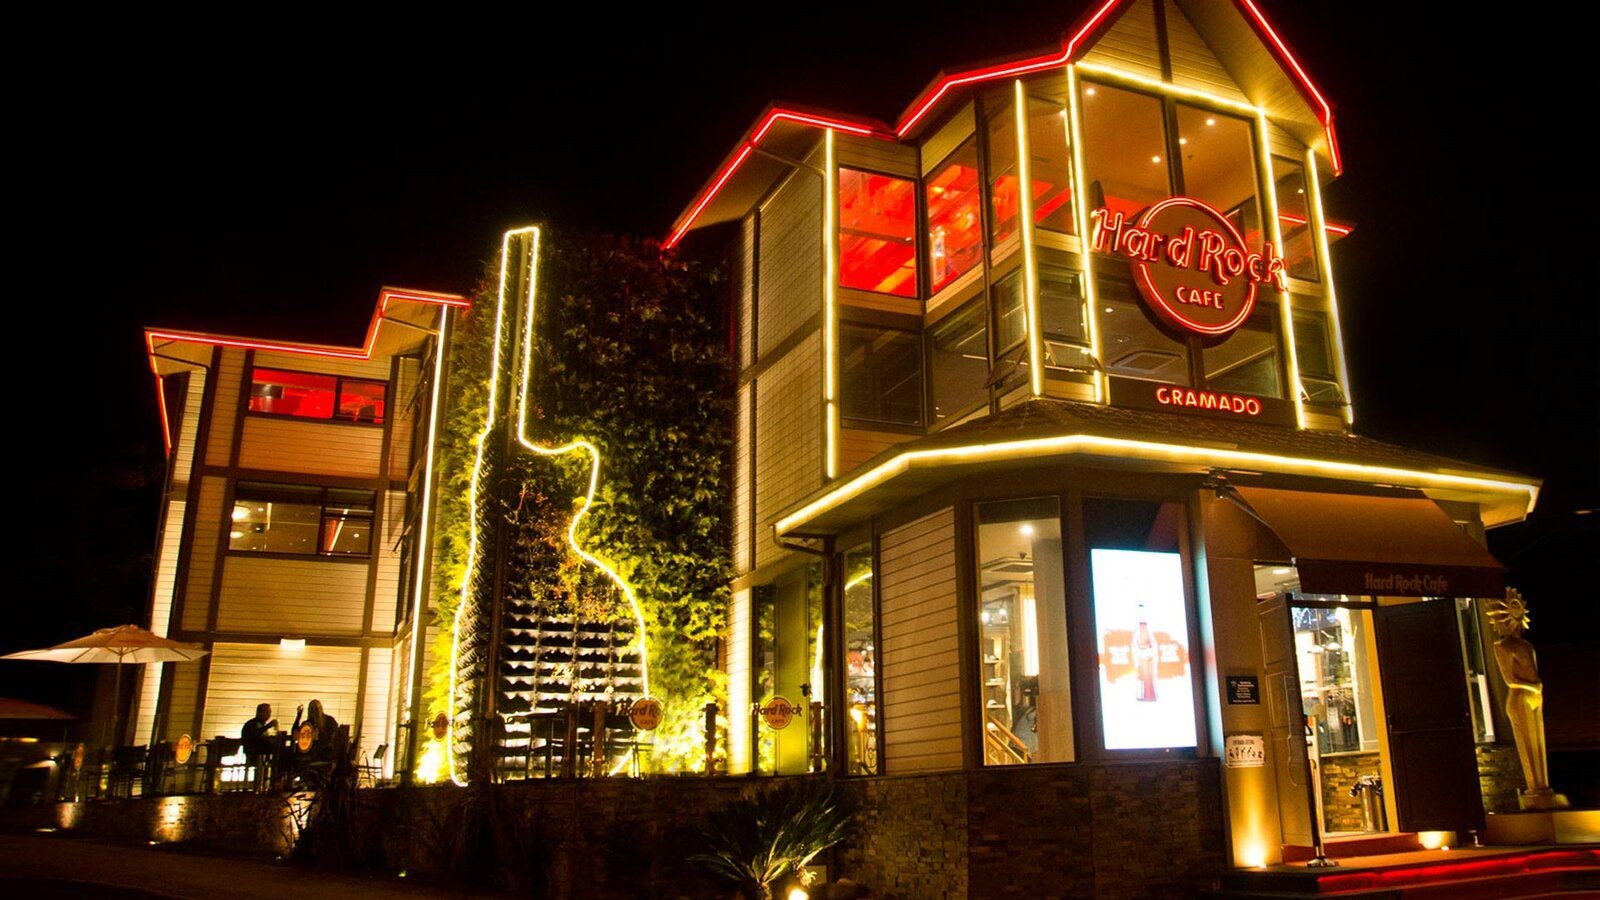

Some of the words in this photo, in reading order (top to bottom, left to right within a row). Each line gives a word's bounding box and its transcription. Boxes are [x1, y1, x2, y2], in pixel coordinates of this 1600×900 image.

[1090, 208, 1194, 268] Hard
[1199, 229, 1289, 293] Rock
[1176, 286, 1224, 310] CAFE
[1155, 387, 1261, 416] GRAMADO
[1365, 572, 1394, 590] Hard
[1395, 574, 1422, 594] Rock
[1423, 574, 1448, 594] Cafe
[752, 702, 780, 716] Hard
[780, 703, 803, 718] Rock
